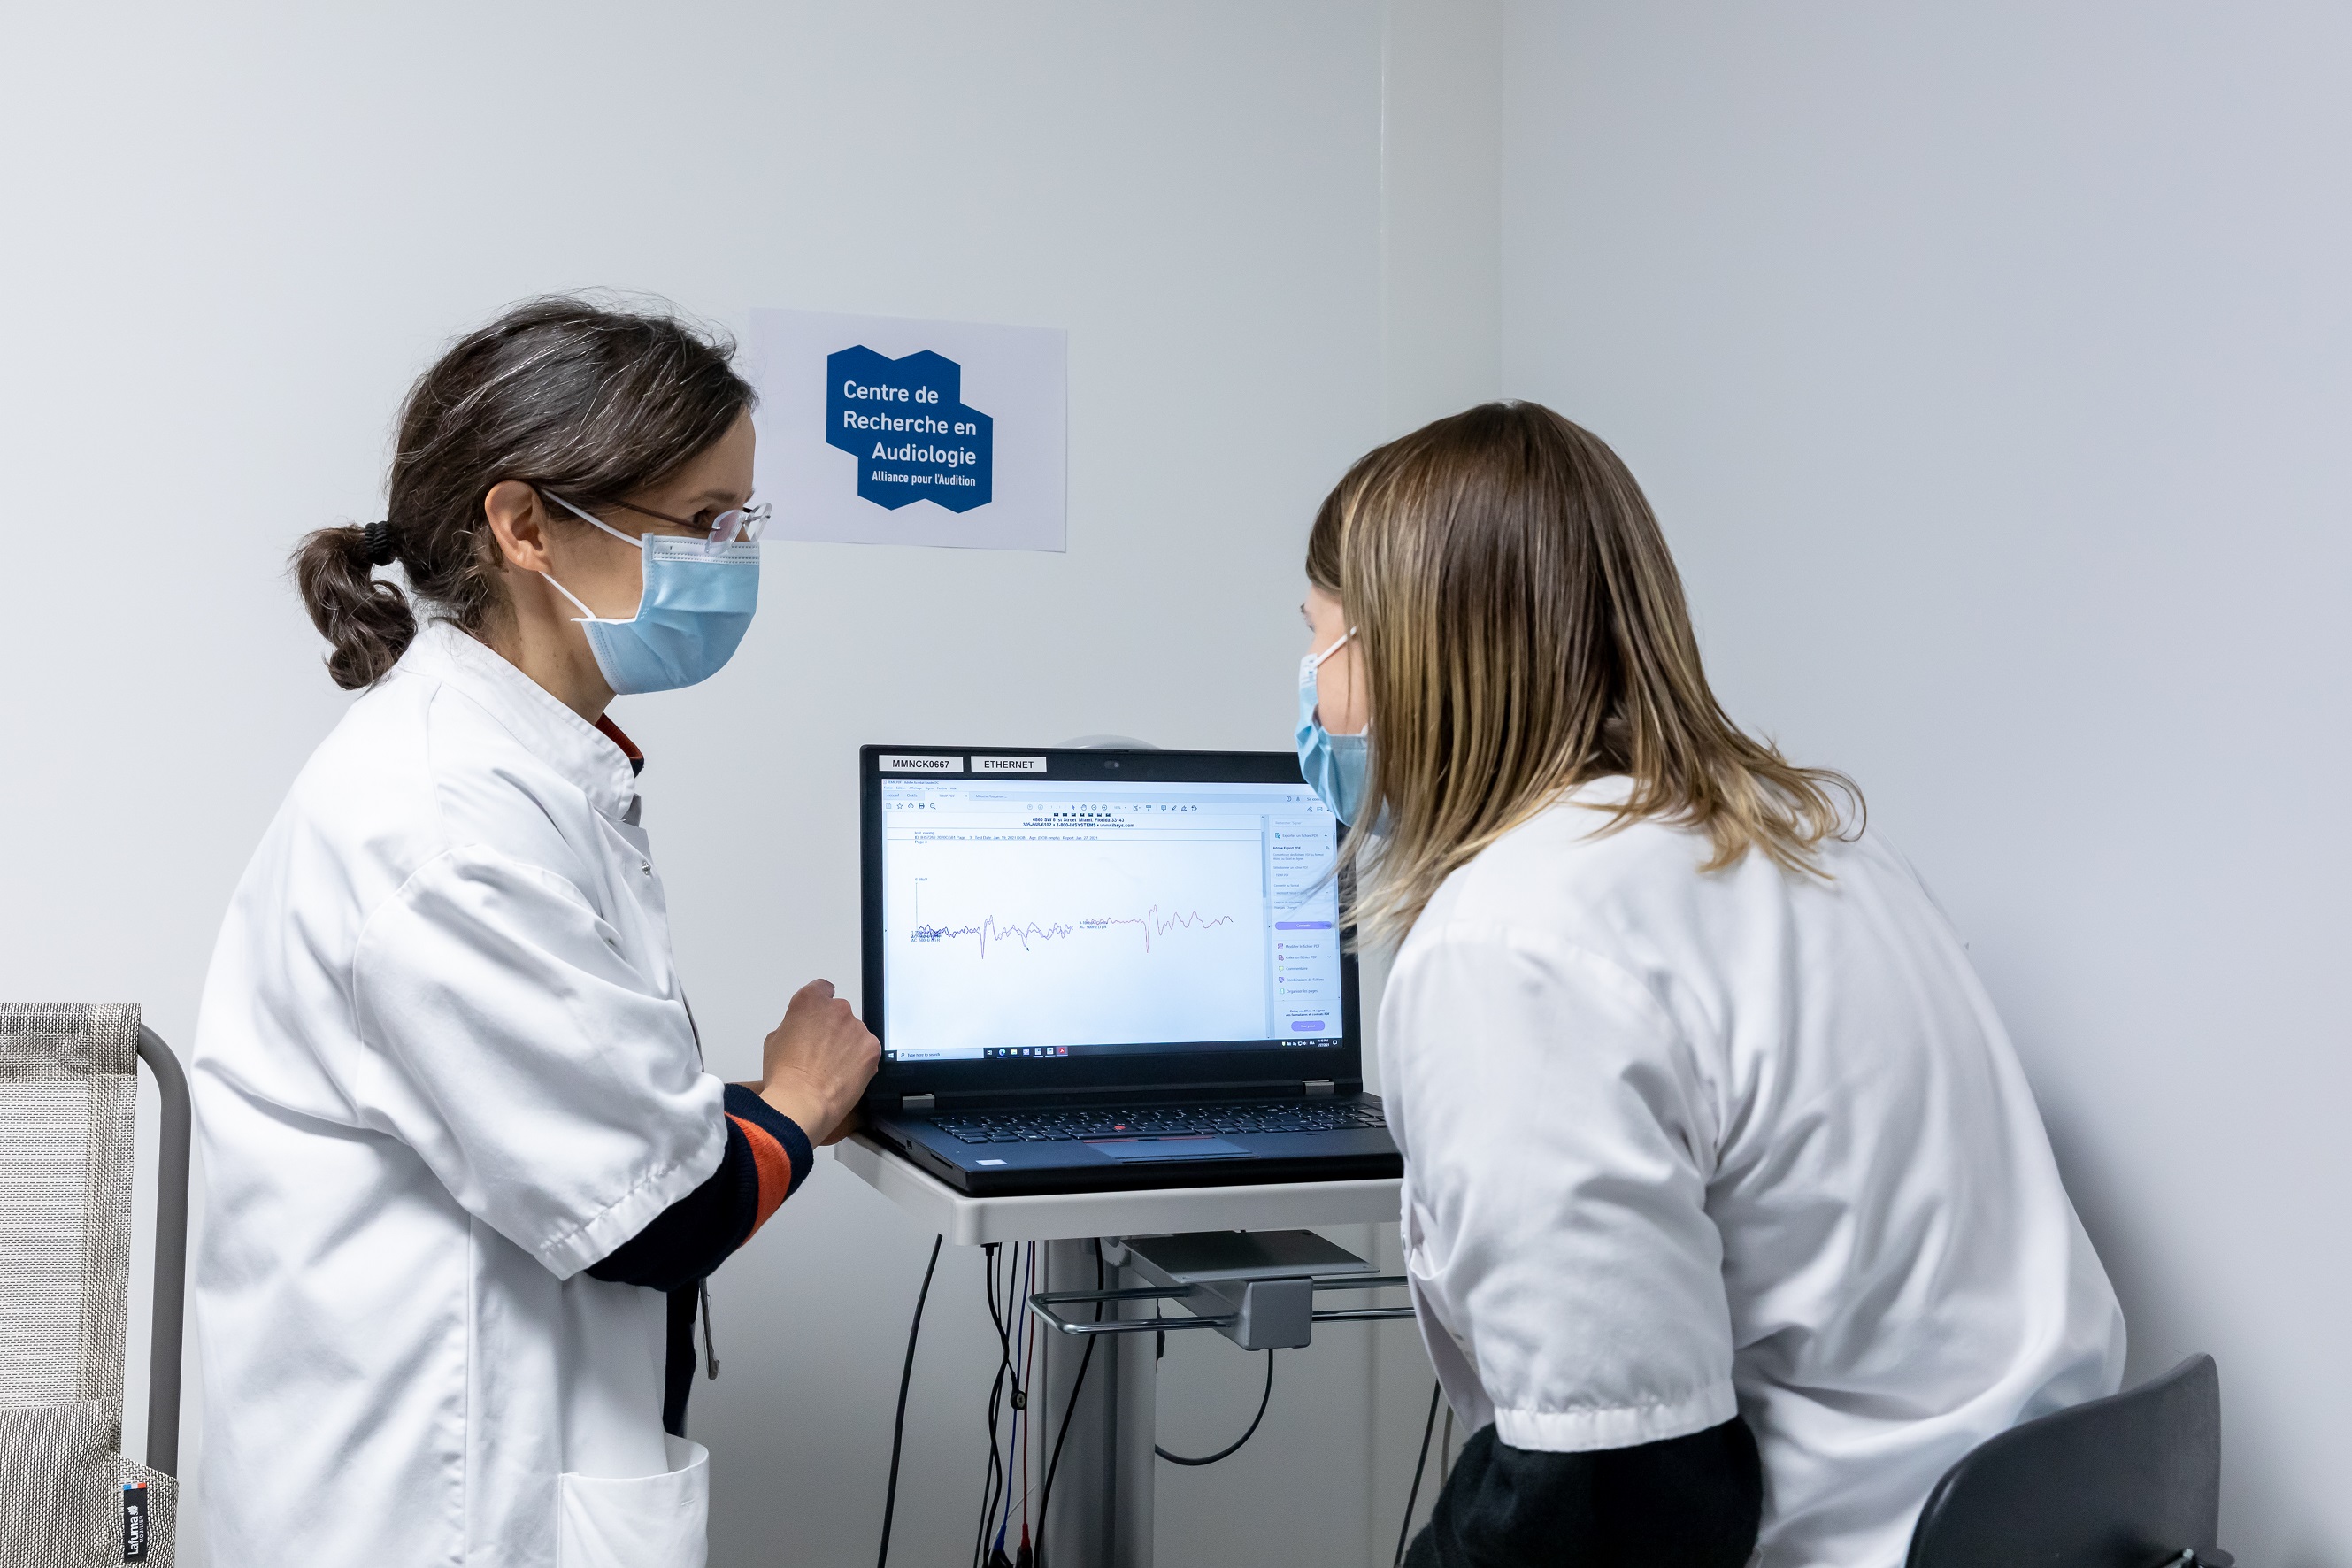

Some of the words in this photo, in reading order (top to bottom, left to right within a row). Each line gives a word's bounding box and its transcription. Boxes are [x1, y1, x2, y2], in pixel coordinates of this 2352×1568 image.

[842, 380, 910, 403] Centre
[914, 385, 939, 404] de
[842, 410, 949, 434] Recherche
[953, 421, 977, 436] en
[871, 442, 977, 468] Audiologie
[871, 470, 909, 483] Alliance
[911, 474, 933, 486] pour
[934, 473, 976, 487] l'Audition
[892, 759, 950, 769] MMNCK0667
[984, 760, 1034, 769] ETHERNET
[127, 1515, 139, 1556] Lafuma
